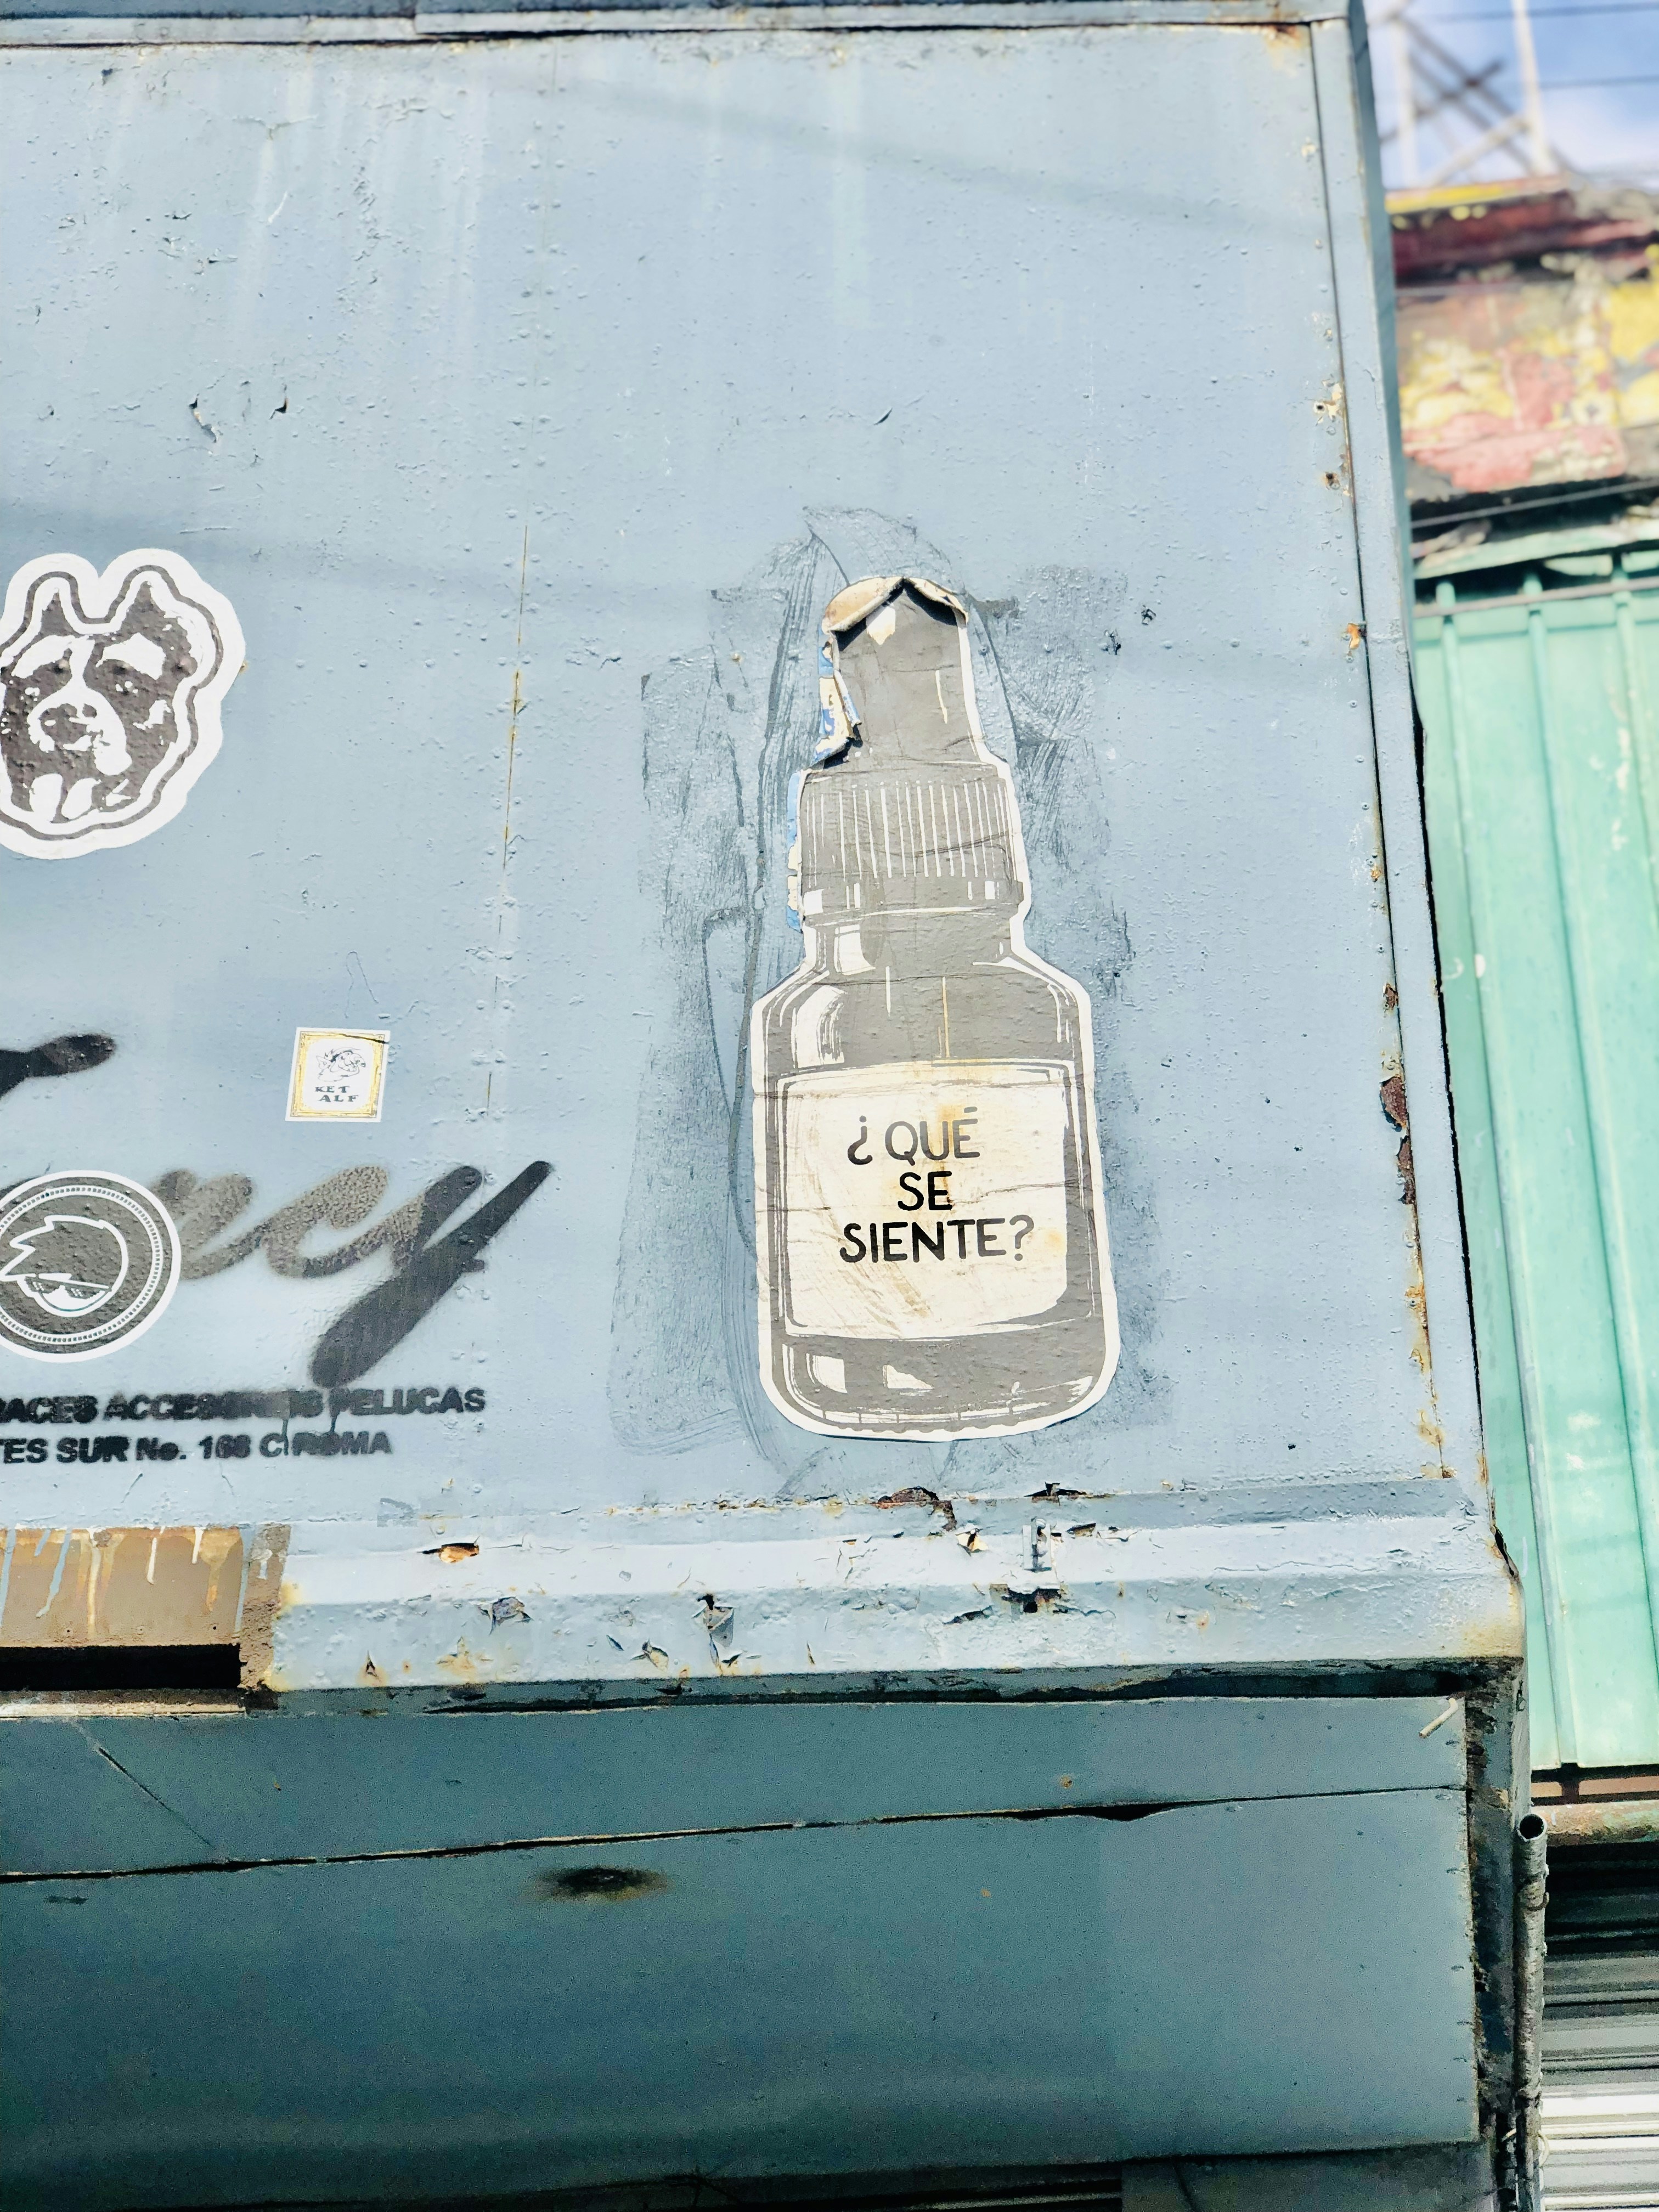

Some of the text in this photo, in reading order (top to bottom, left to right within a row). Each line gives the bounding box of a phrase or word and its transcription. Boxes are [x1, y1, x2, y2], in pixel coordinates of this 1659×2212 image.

[897, 1170, 953, 1211] SE
[839, 1214, 1035, 1263] SIENTE?
[57, 1436, 129, 1463] SUR
[136, 1437, 187, 1462] No.
